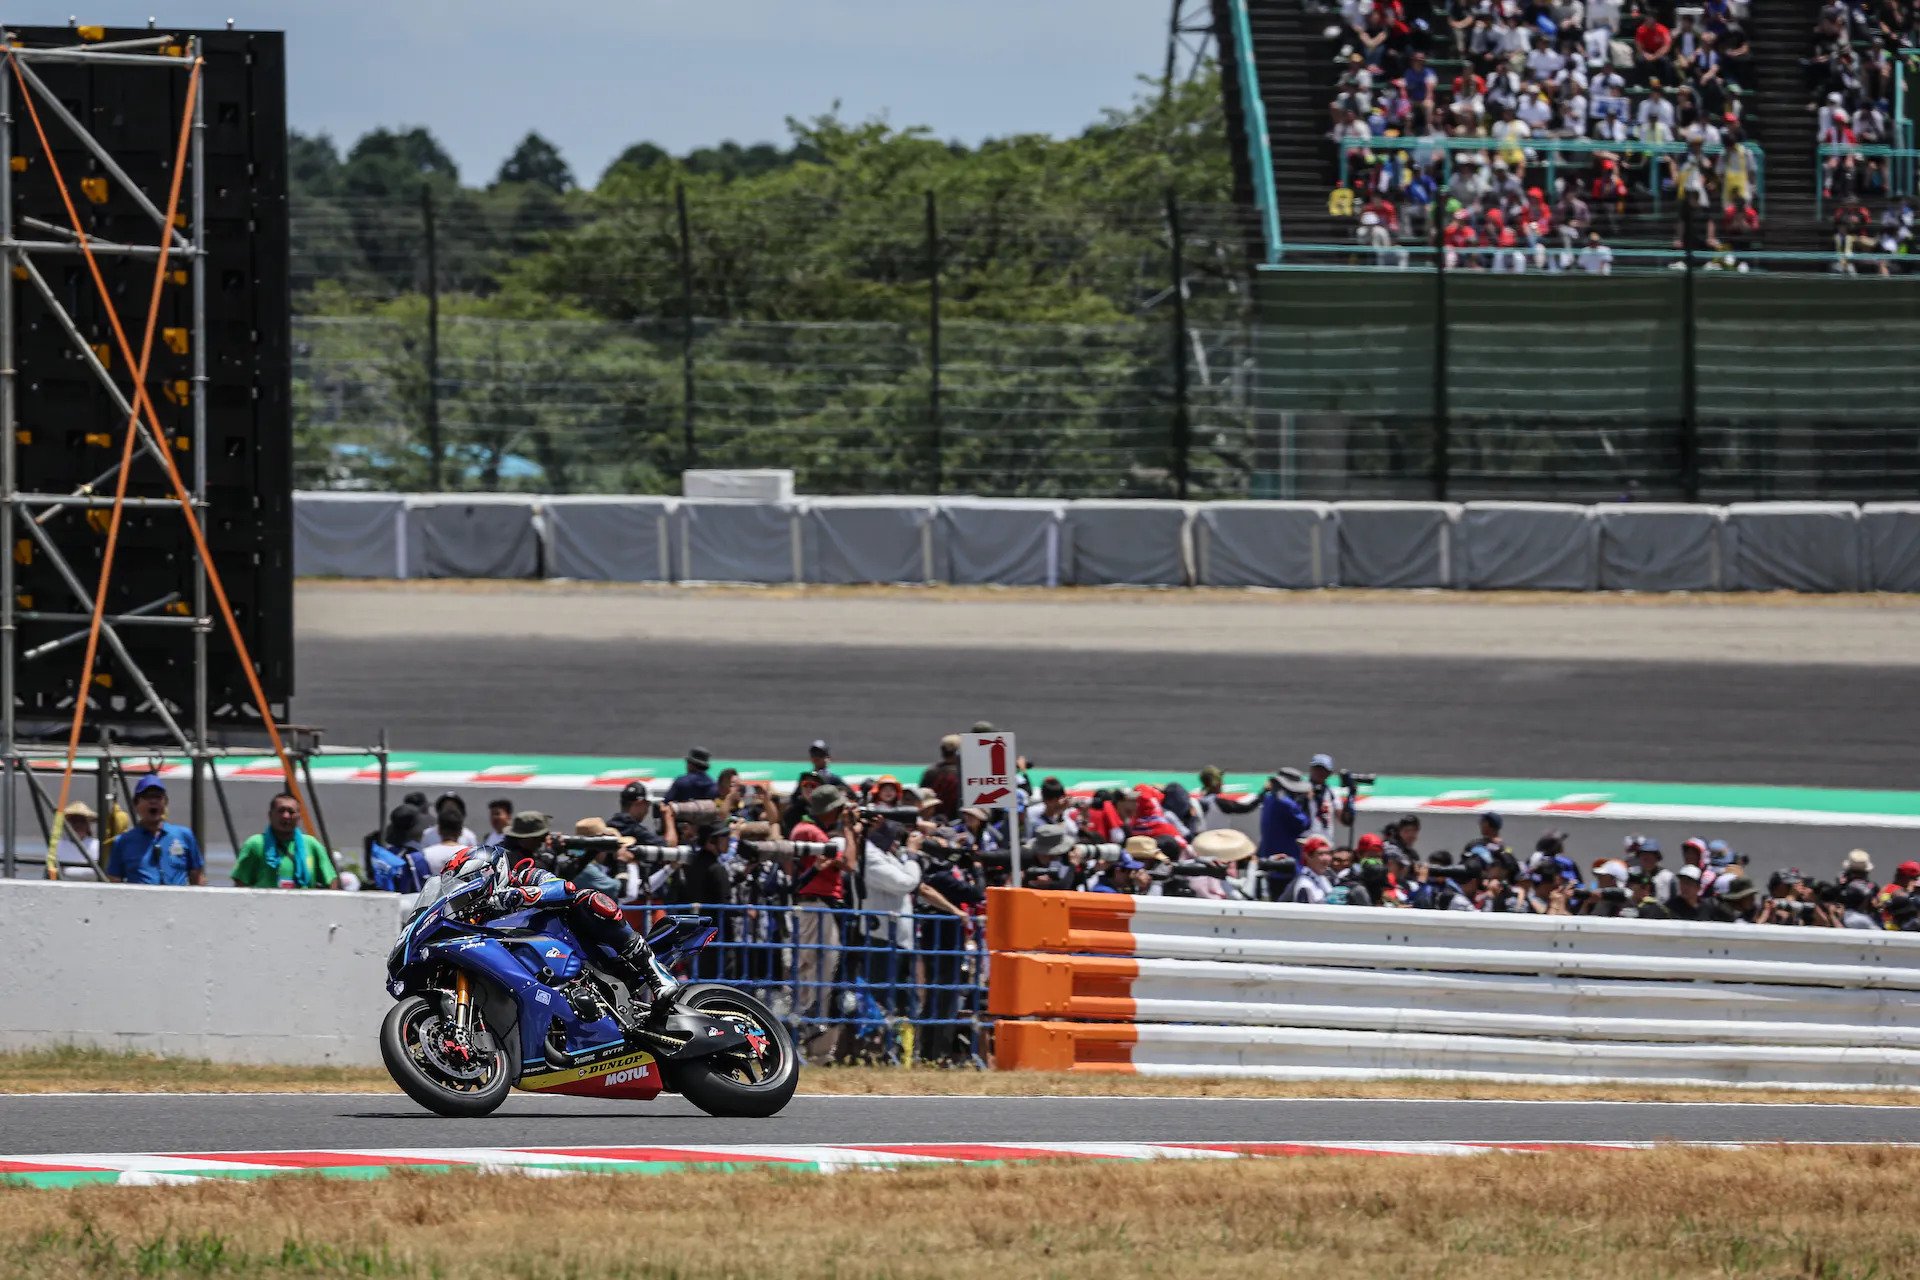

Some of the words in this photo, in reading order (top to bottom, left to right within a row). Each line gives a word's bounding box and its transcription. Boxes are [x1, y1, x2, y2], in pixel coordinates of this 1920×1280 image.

[967, 776, 1008, 785] FIRE
[602, 1046, 625, 1056] GYTR
[589, 1055, 643, 1073] DUNLOP
[605, 1065, 649, 1087] MOTUL
